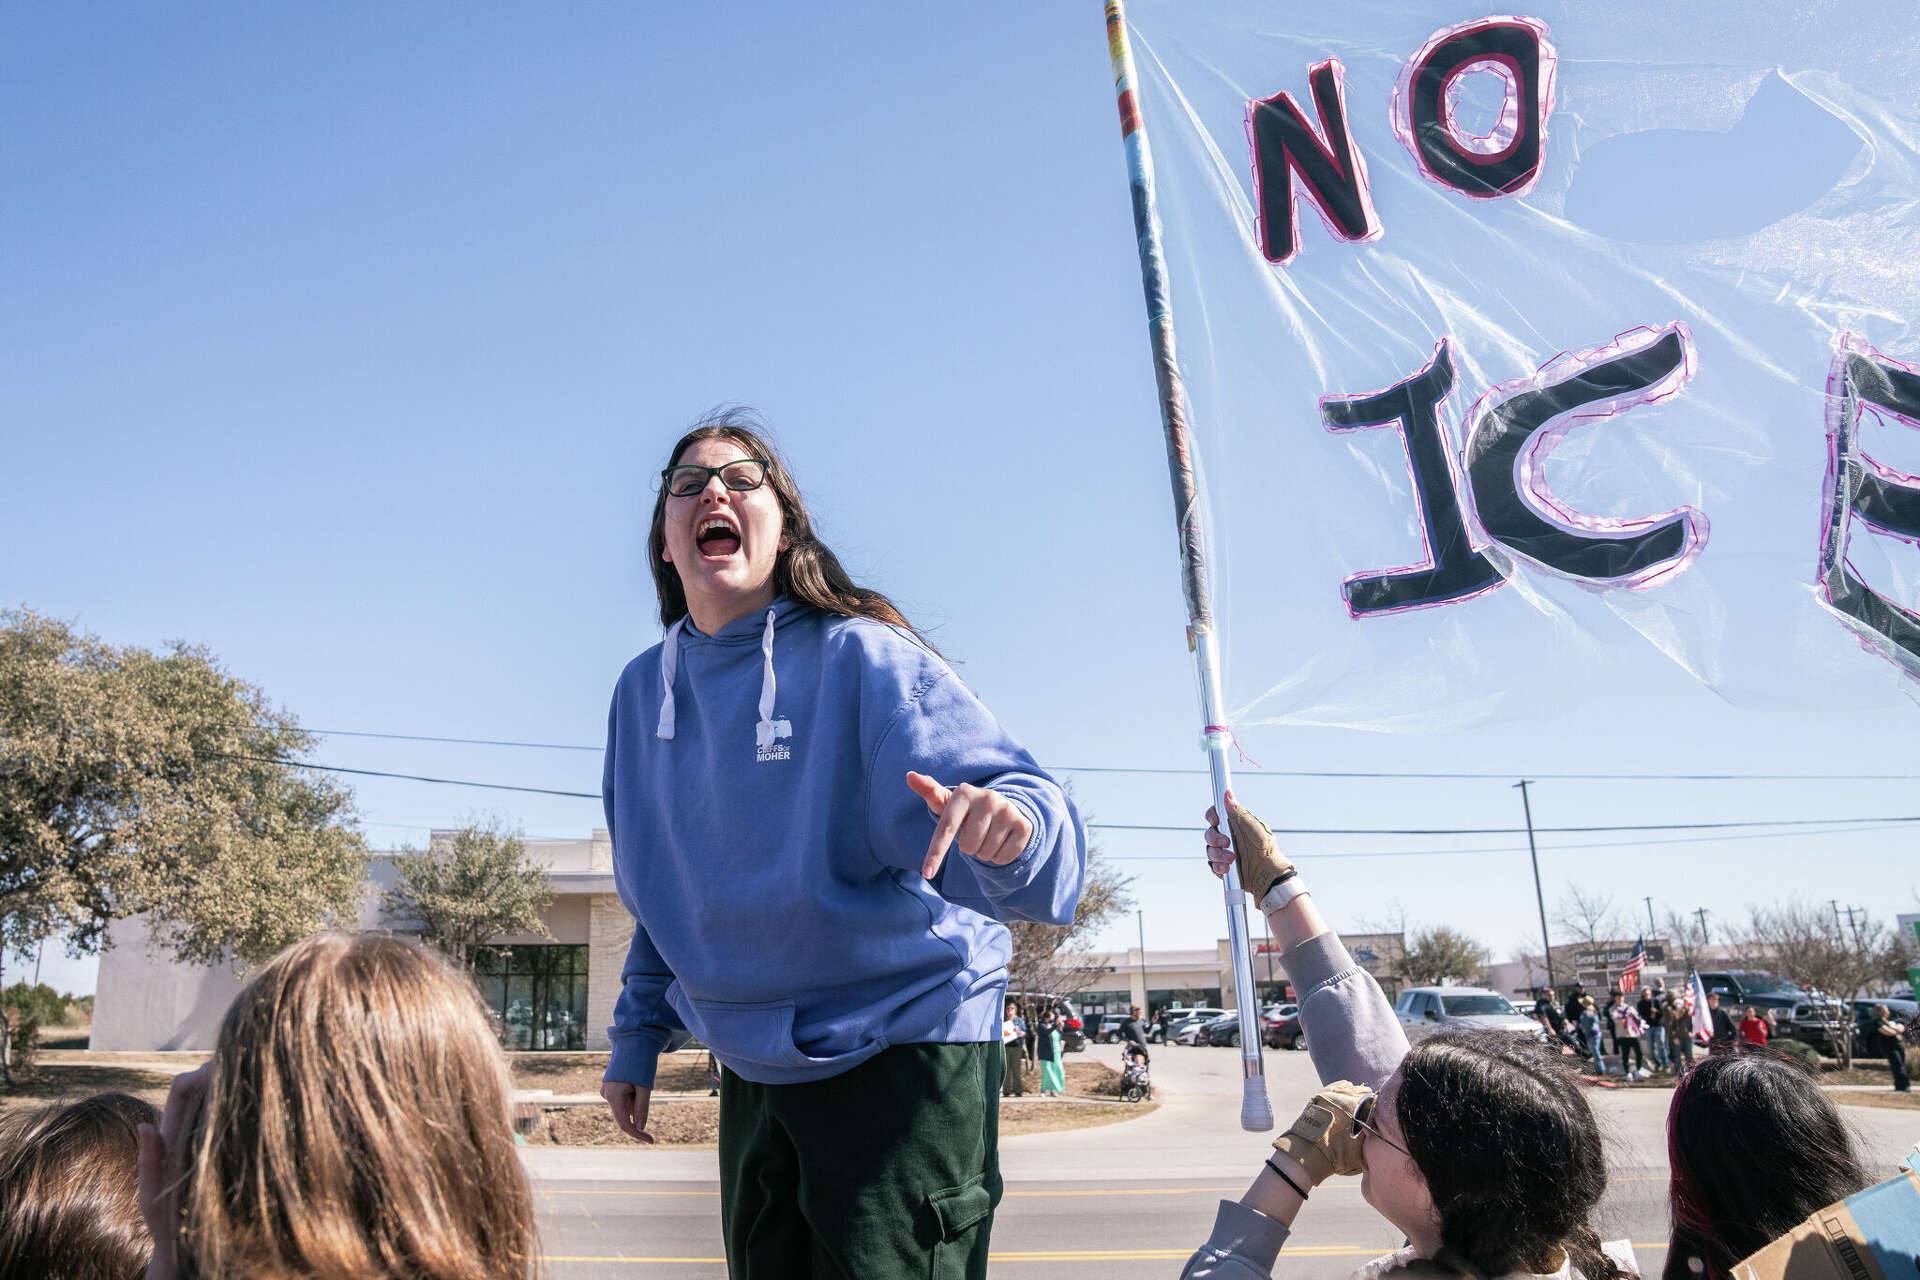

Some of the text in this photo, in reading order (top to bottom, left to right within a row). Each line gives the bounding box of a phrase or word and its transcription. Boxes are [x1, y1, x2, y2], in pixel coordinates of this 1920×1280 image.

[1245, 15, 1556, 266] NO
[1319, 321, 1920, 684] ICE
[757, 751, 790, 762] MOHER
